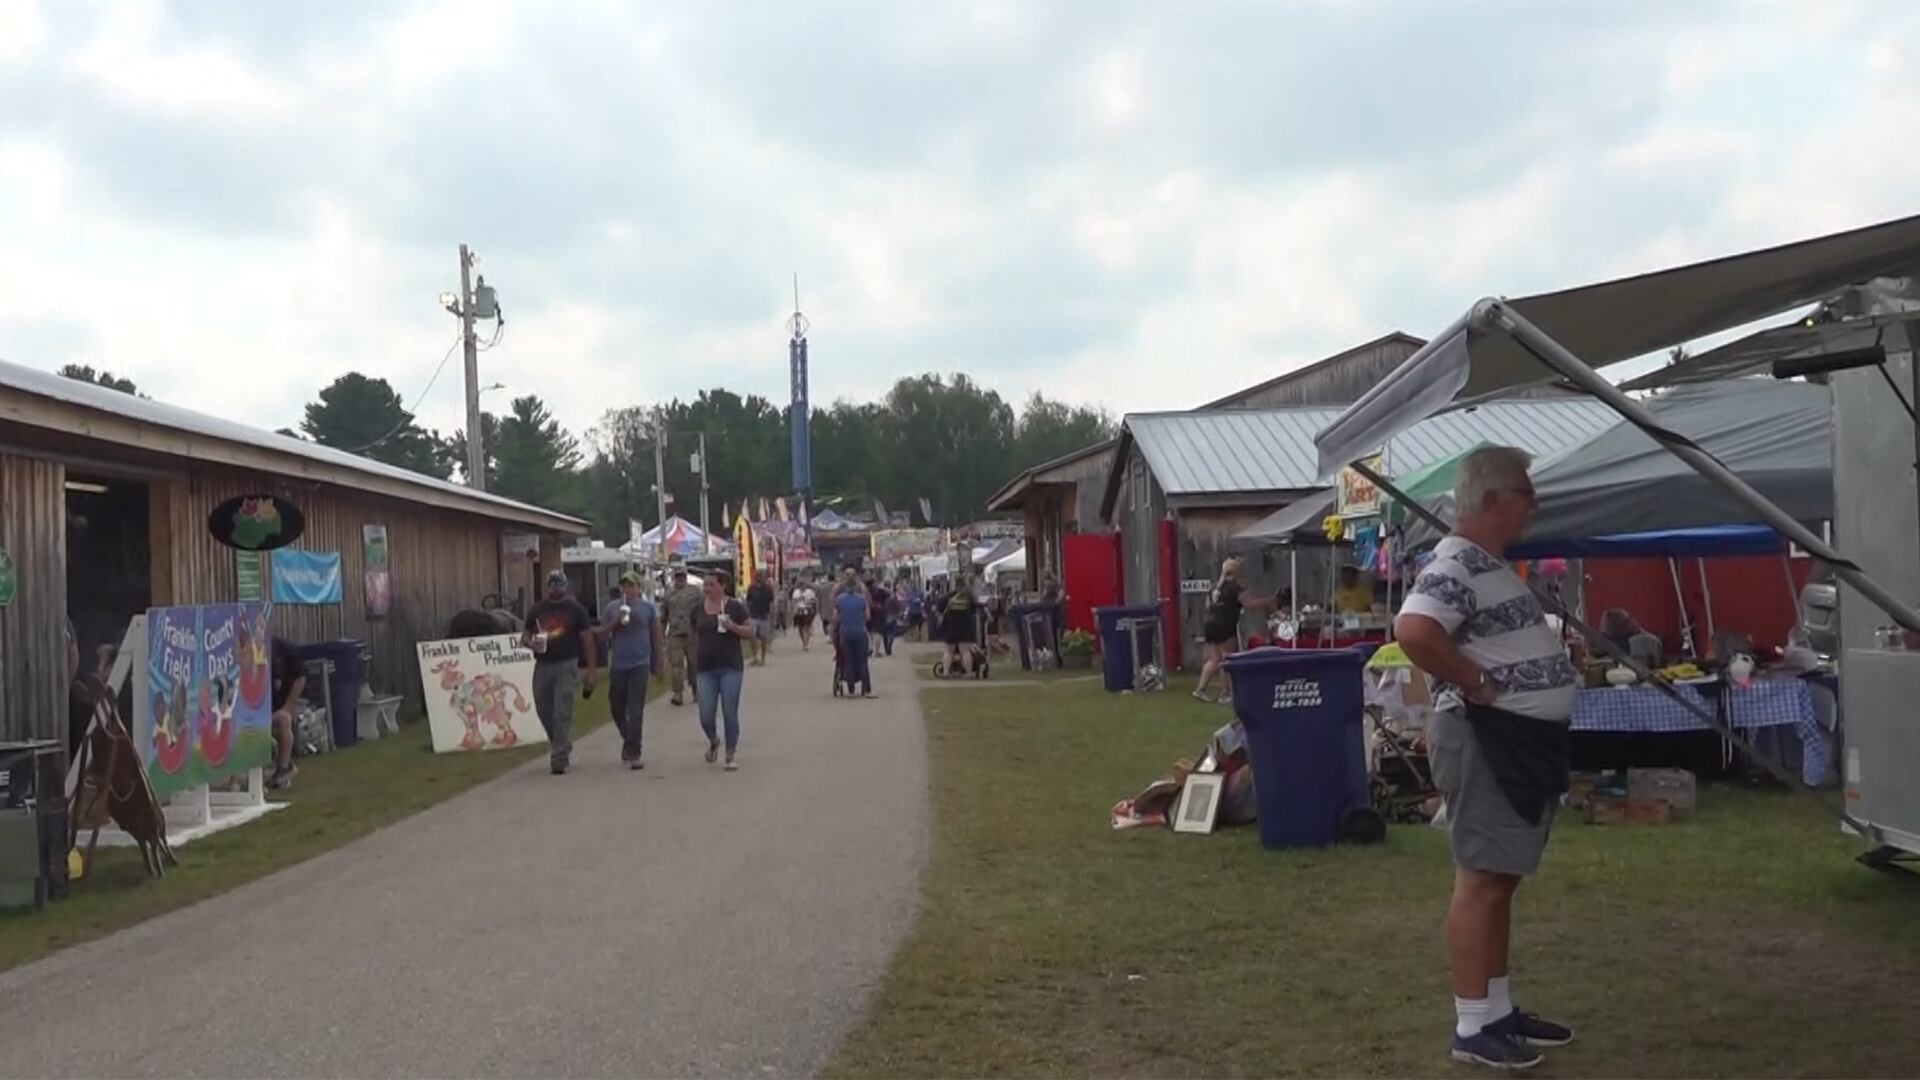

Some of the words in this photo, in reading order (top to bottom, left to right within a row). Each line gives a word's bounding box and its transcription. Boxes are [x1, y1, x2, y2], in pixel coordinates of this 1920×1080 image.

[1182, 581, 1210, 590] MEN
[164, 616, 196, 652] Franklin
[204, 615, 234, 651] County
[422, 643, 460, 658] Franklin
[468, 639, 502, 654] County
[163, 645, 191, 688] Field
[208, 648, 234, 681] Days
